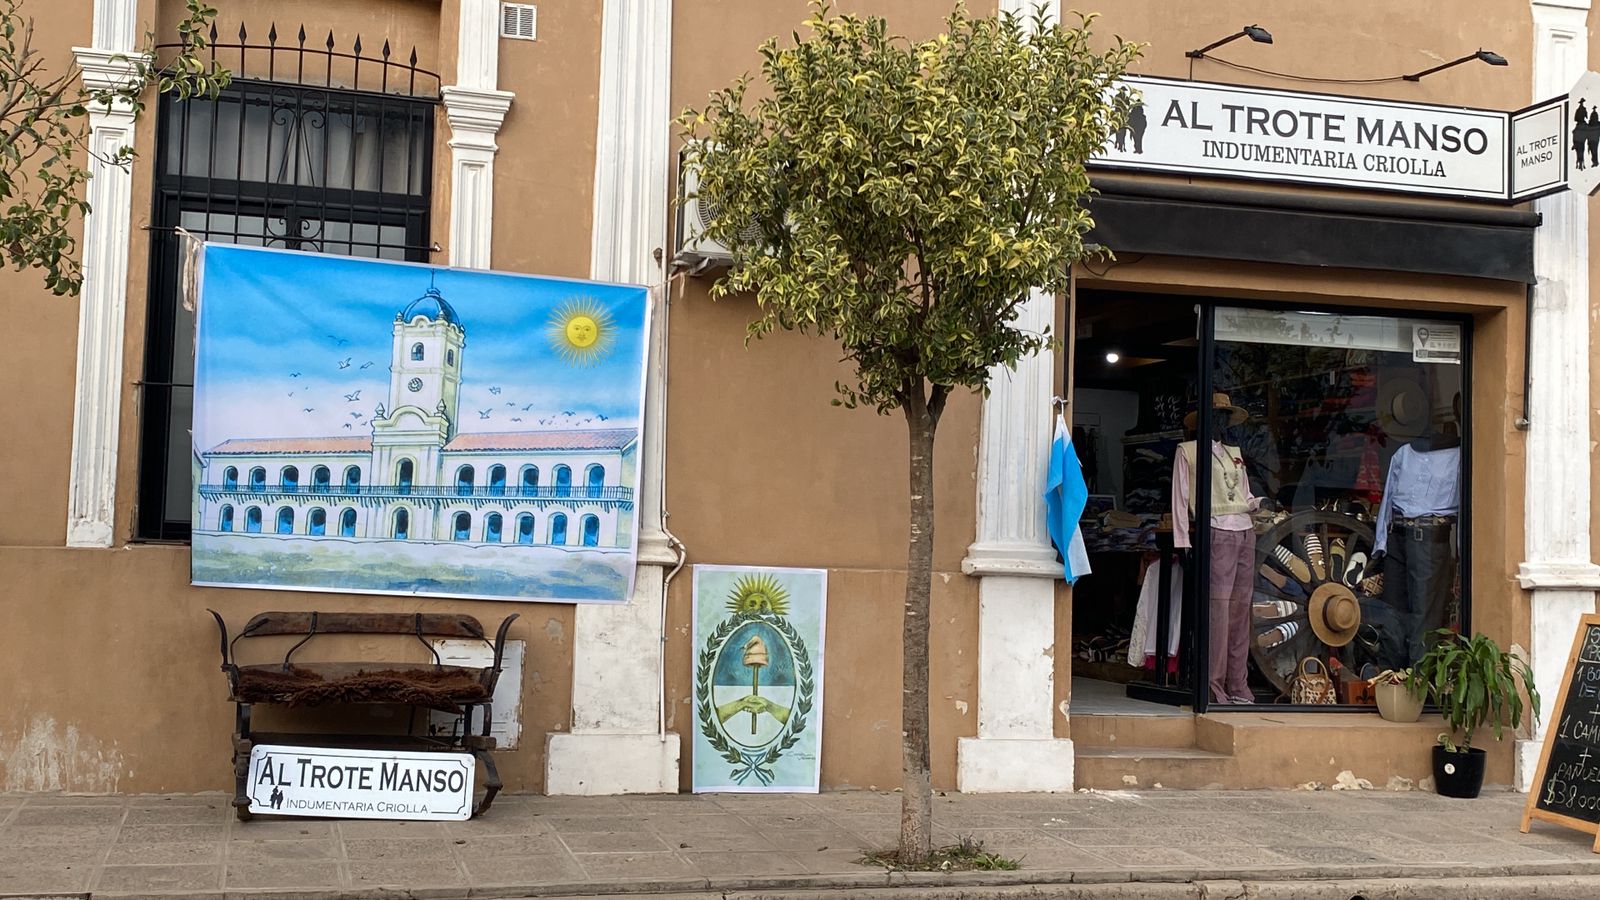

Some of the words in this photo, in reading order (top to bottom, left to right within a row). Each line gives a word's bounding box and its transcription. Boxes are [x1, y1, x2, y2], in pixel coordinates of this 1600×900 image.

[1161, 99, 1213, 131] AL
[1221, 103, 1345, 143] TROTE
[1356, 117, 1488, 155] MANSO
[1202, 140, 1357, 170] INDUMENTARIA
[1363, 153, 1447, 178] CRIOLLA
[1516, 145, 1528, 156] AL
[1529, 135, 1558, 151] TROTE
[1521, 151, 1553, 168] MANSO
[258, 756, 291, 786] AL
[297, 758, 373, 790] TROTE
[379, 762, 464, 793] MANSO
[286, 798, 374, 812] INDUMENTARIA
[376, 801, 428, 814] CRIOLLA
